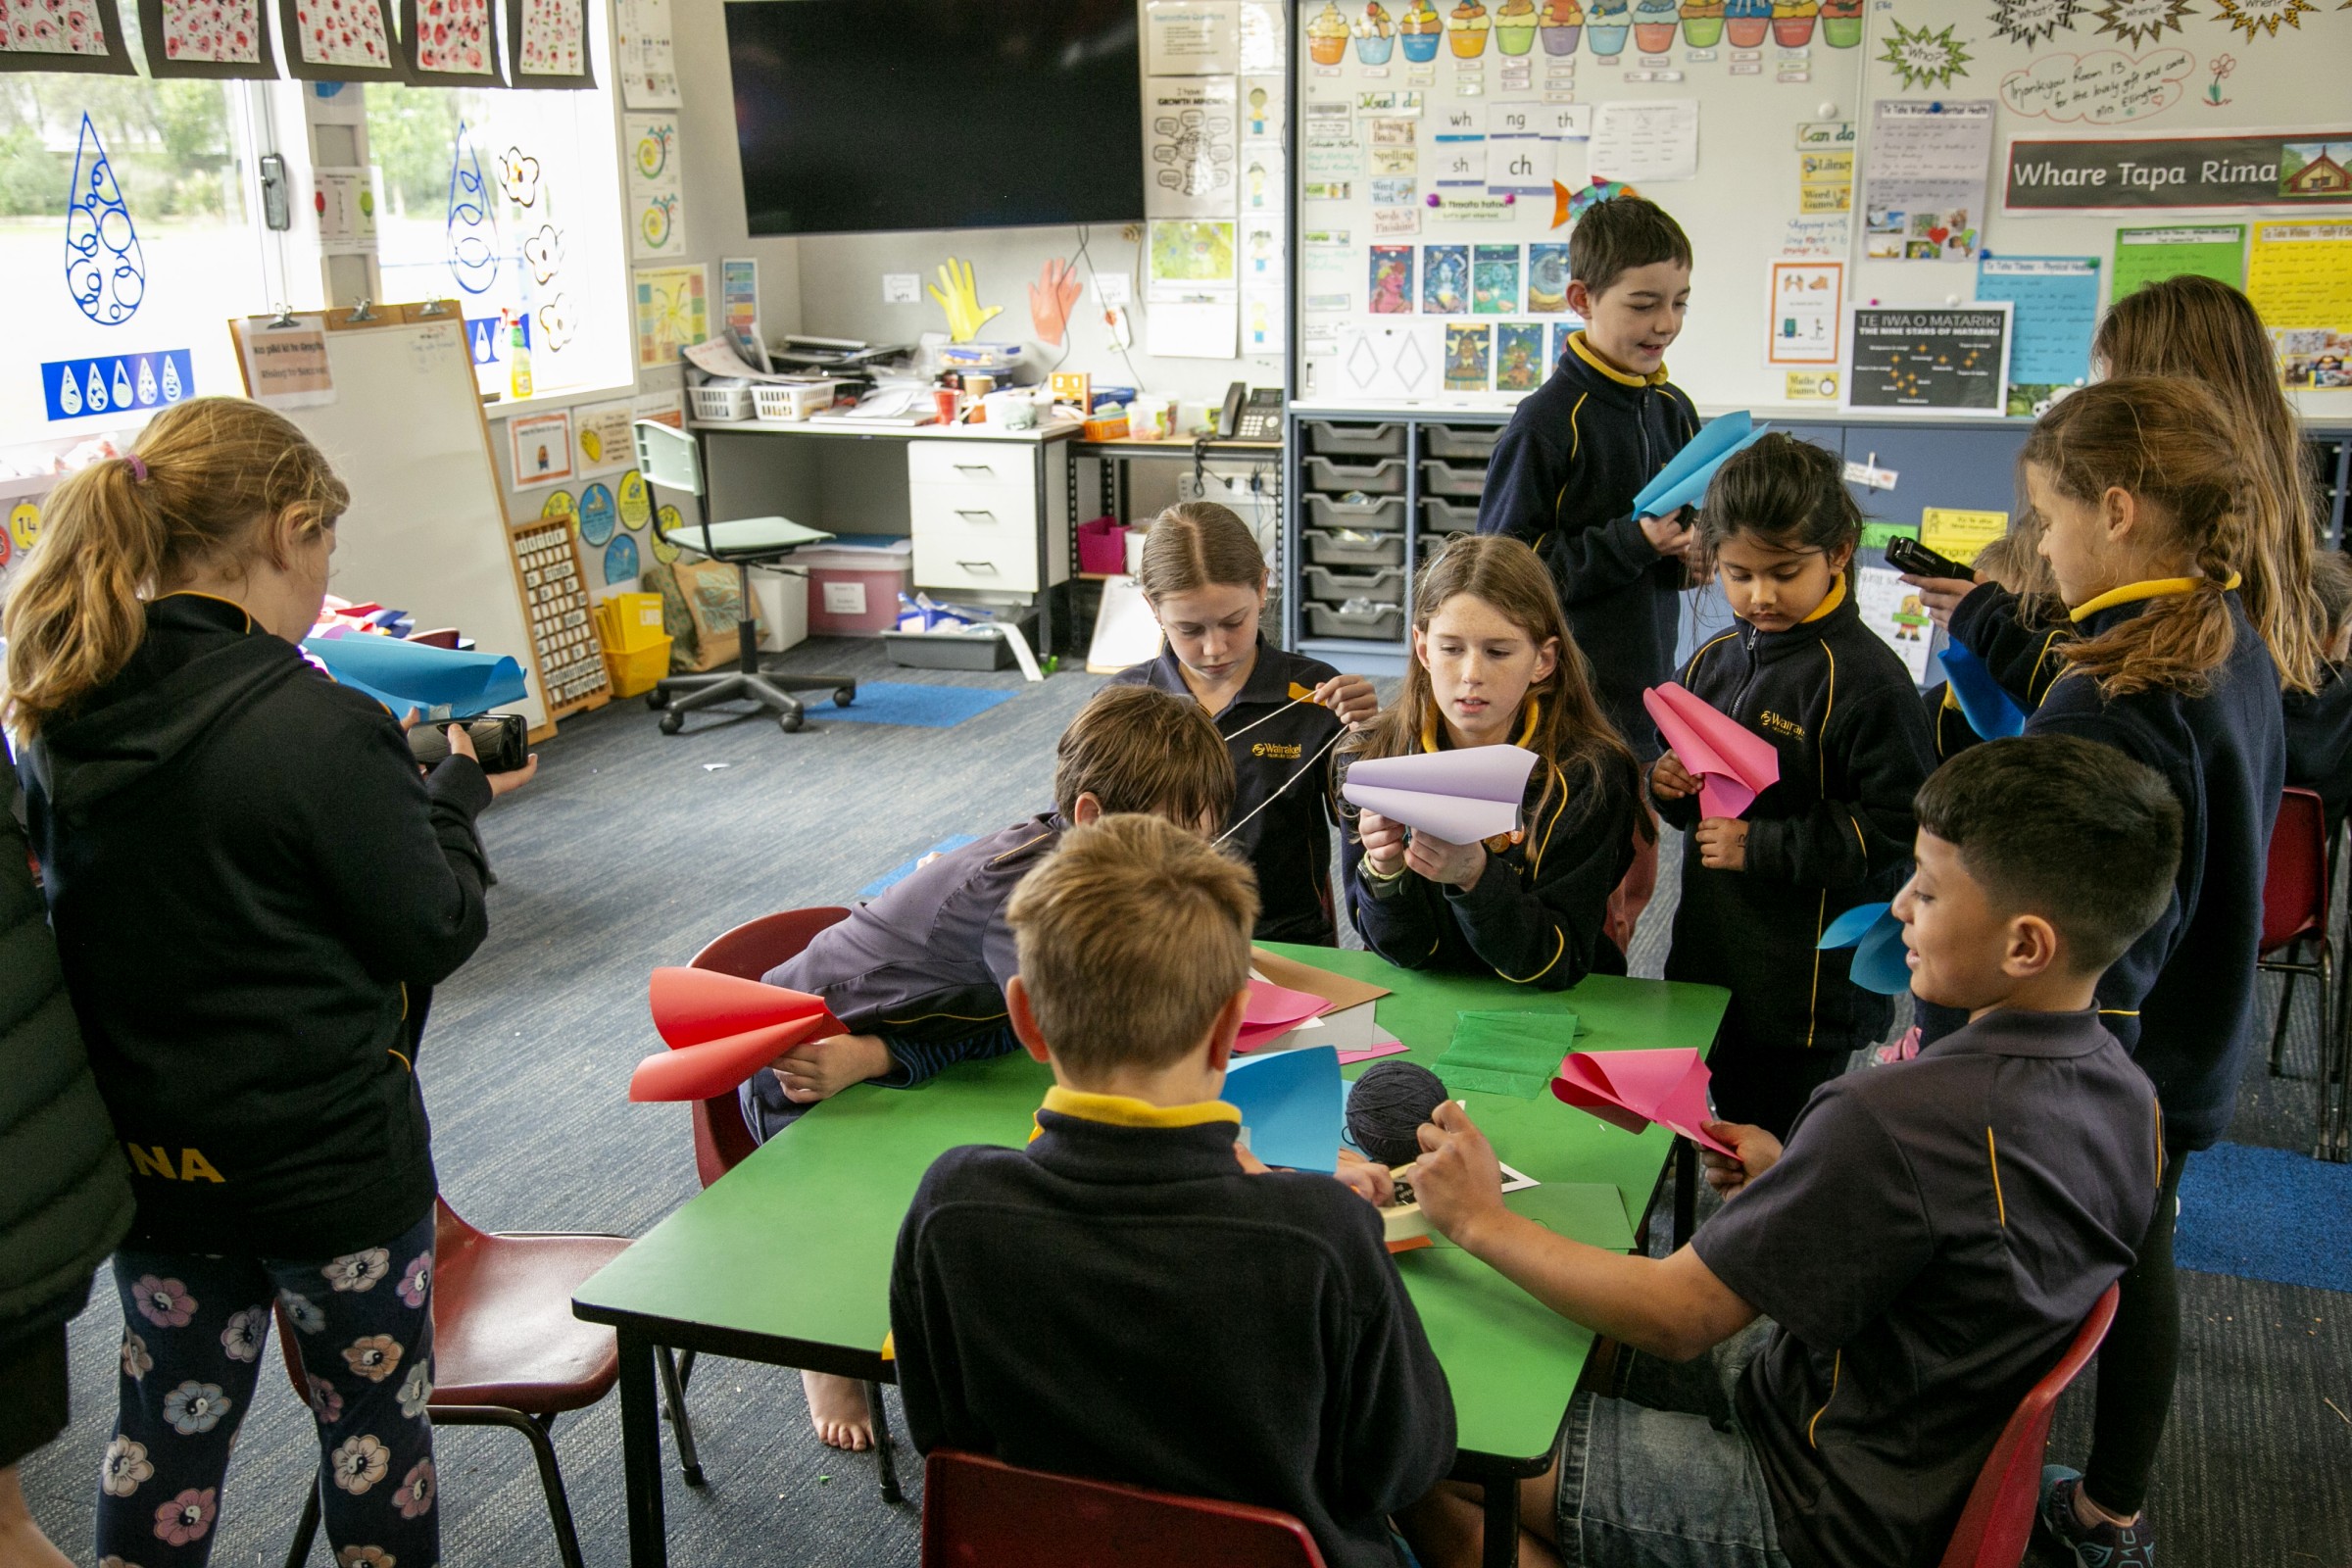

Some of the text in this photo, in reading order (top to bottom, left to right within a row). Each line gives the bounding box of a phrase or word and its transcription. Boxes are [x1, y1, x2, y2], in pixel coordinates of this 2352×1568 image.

[2019, 3, 2055, 20] What?
[2125, 3, 2163, 18] Where?
[1908, 45, 1943, 63] Who?
[2073, 66, 2103, 84] Room
[2110, 61, 2127, 75] 13
[2054, 91, 2068, 109] for
[2072, 89, 2088, 101] the
[2092, 80, 2120, 99] lovely
[2123, 70, 2140, 94] gift
[2143, 65, 2162, 81] and
[1402, 91, 1421, 109] do
[2121, 84, 2164, 108] Ellington
[1449, 111, 1472, 126] wh
[1506, 114, 1526, 130] ng
[1557, 112, 1574, 128] th
[1799, 122, 1856, 143] Can do
[1373, 151, 1416, 164] Spelling
[1452, 157, 1470, 173] sh
[1508, 154, 1534, 176] ch
[1818, 158, 1852, 172] Library
[2014, 158, 2278, 192] Whare Tapa Rima
[1372, 180, 1396, 192] Word
[1372, 193, 1396, 203] Work
[1803, 190, 1832, 199] Word
[1803, 201, 1835, 210] Games
[1374, 211, 1400, 221] Needs
[1860, 315, 2001, 327] TE IWA O MATARIKI
[1858, 327, 1879, 336] THE
[1905, 327, 1936, 336] STARS
[1951, 327, 2001, 336] MATARIKI
[1789, 375, 1816, 385] Maths
[18, 516, 37, 535] 14
[1264, 743, 1302, 755] Wairakei
